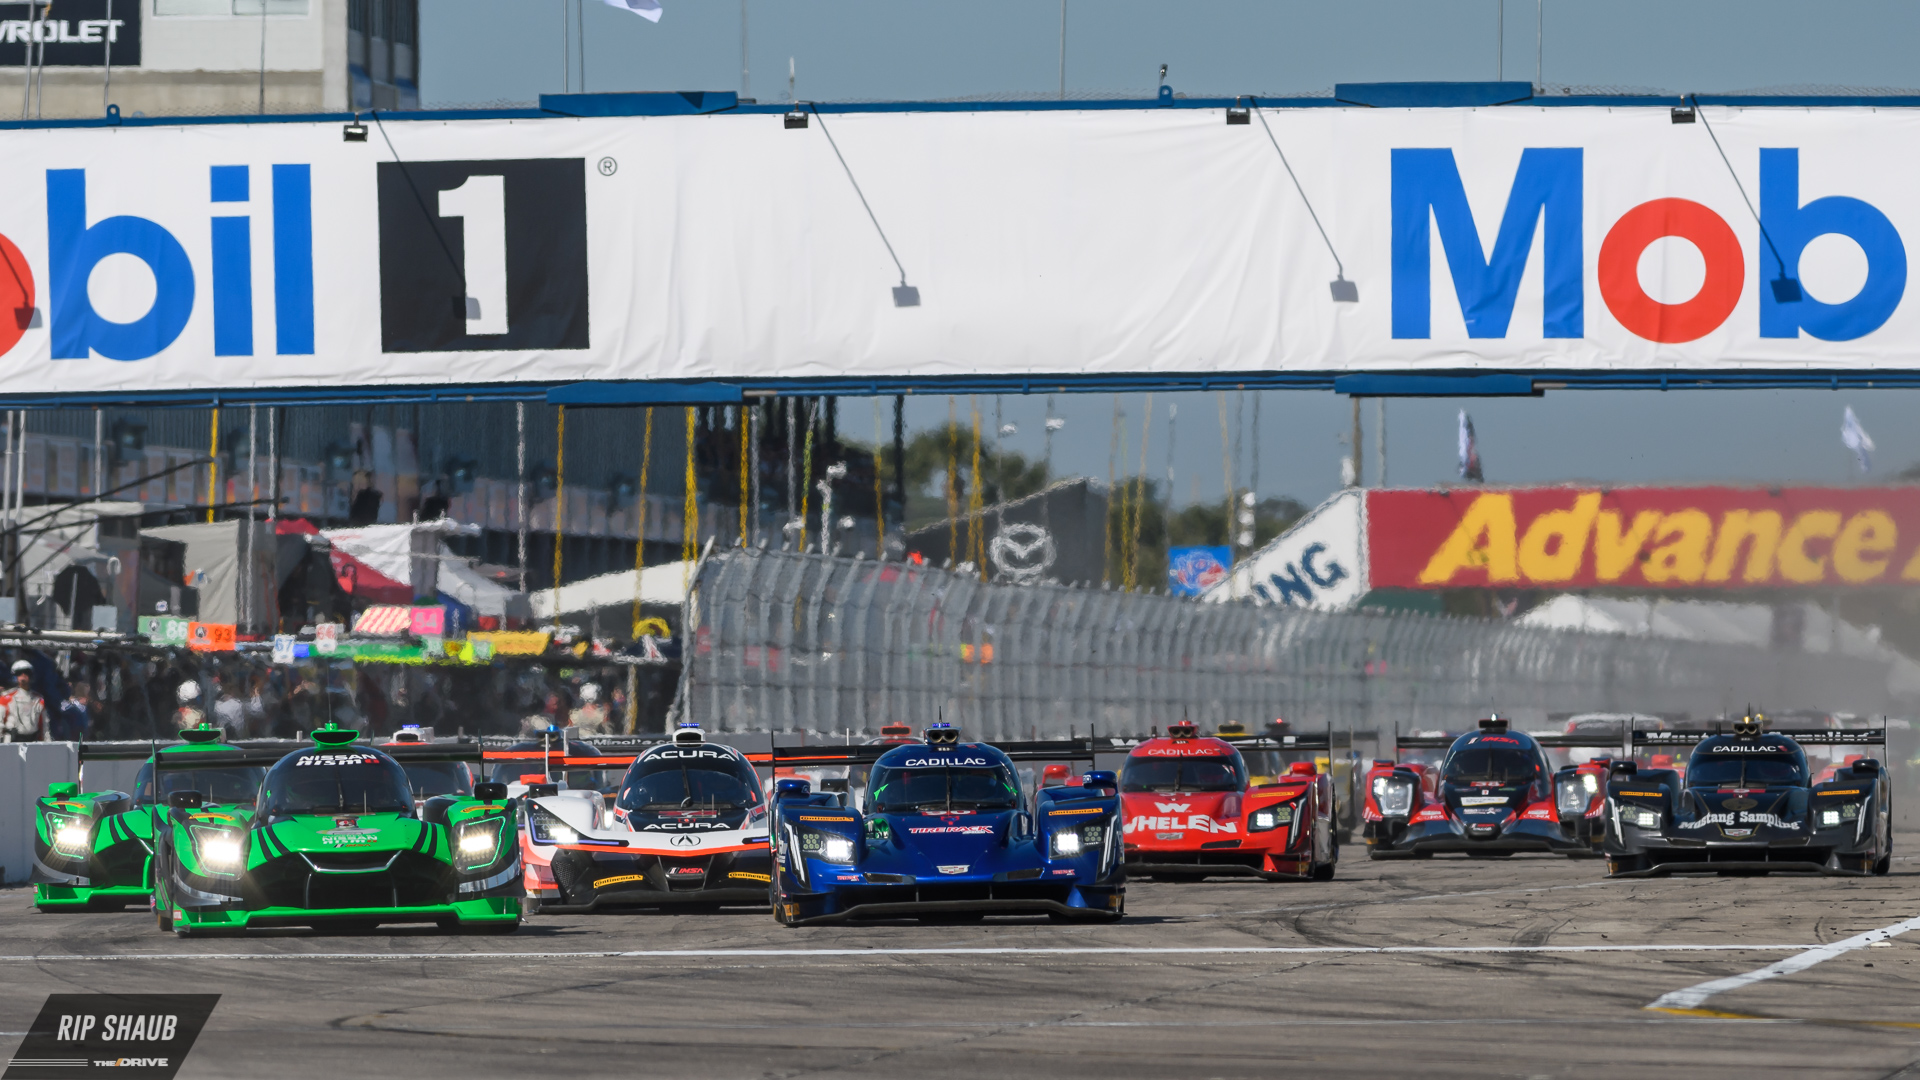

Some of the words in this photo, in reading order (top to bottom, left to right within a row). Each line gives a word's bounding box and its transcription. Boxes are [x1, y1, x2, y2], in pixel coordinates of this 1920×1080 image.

[1390, 147, 1908, 344] Mob
[0, 163, 315, 361] bil
[438, 175, 510, 336] 1
[1417, 491, 1899, 583] Advance
[214, 628, 232, 643] 93
[275, 637, 293, 652] 67
[643, 750, 736, 762] ACURA
[1147, 748, 1214, 756] CADILLAC
[905, 757, 987, 767] CADILLAC
[643, 822, 731, 830] ACURA
[1678, 812, 1736, 829] Mustang
[1739, 811, 1801, 830] Sampling
